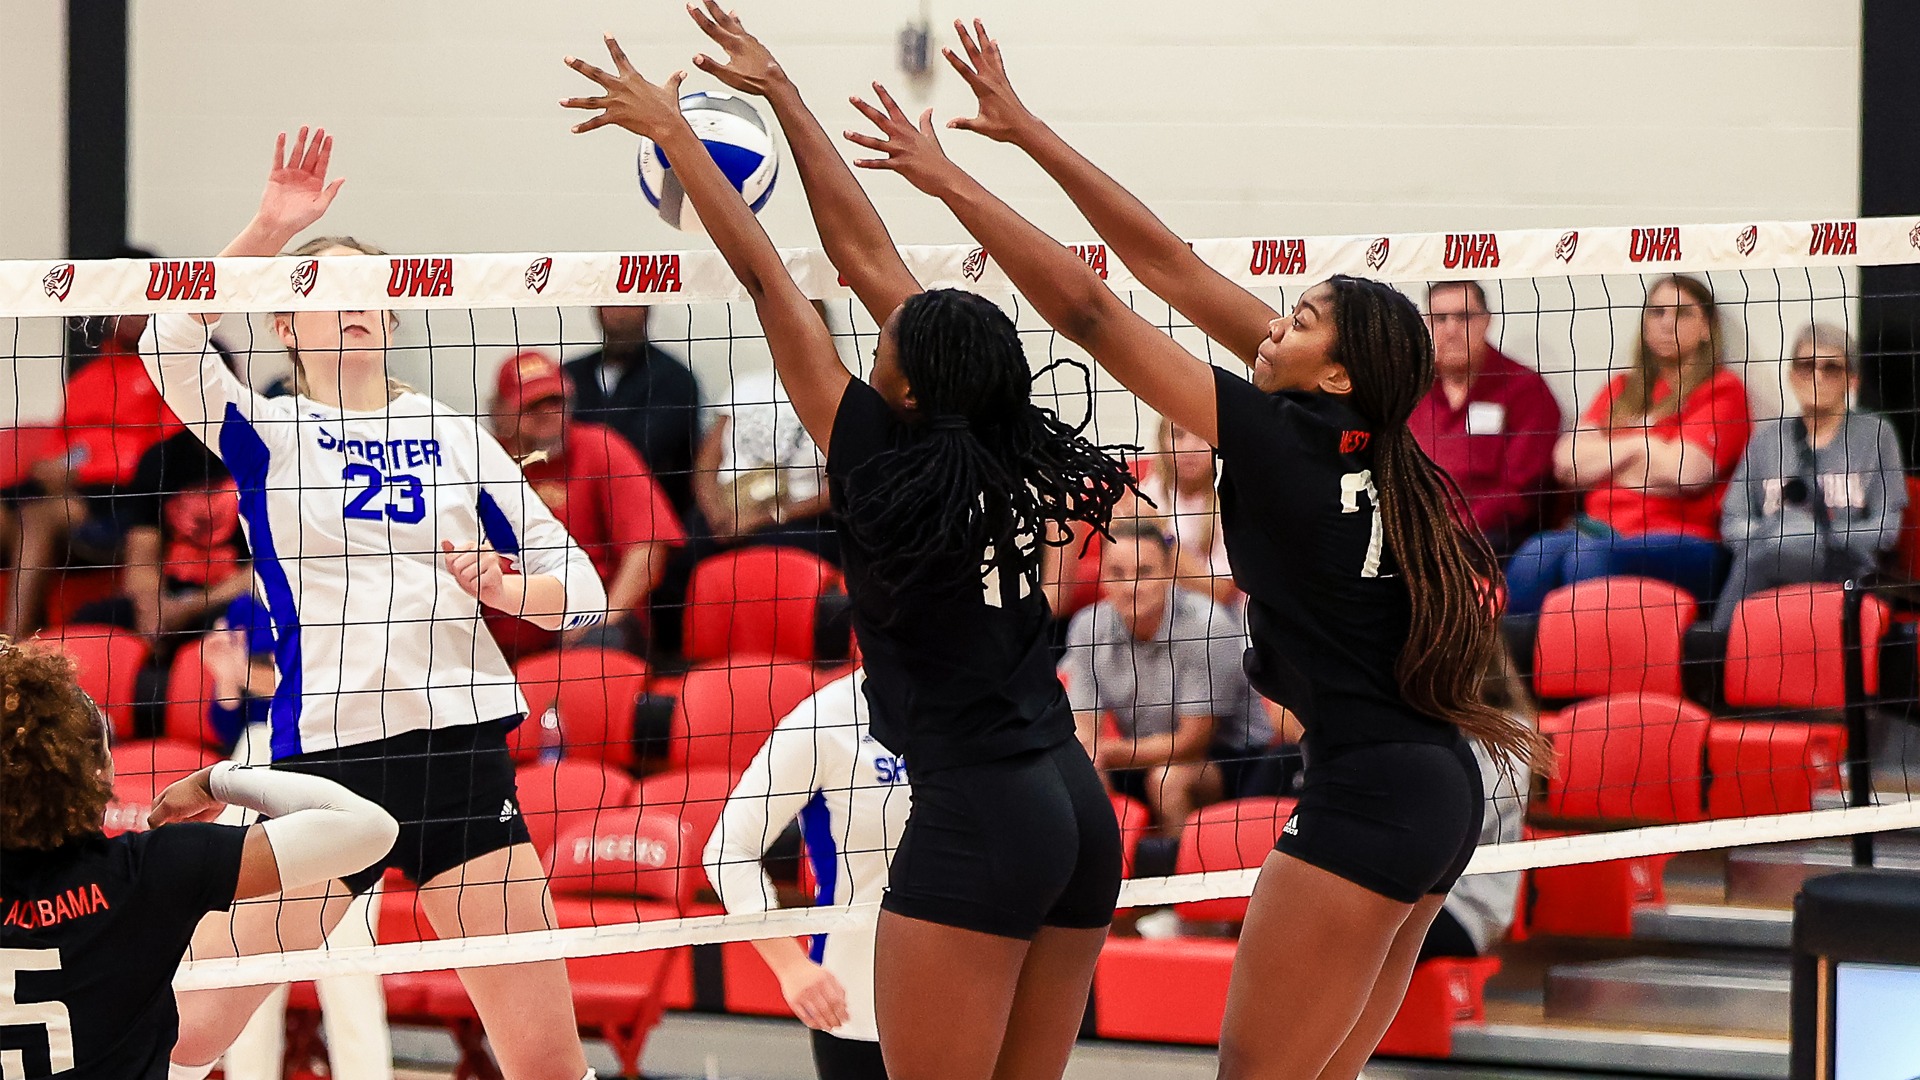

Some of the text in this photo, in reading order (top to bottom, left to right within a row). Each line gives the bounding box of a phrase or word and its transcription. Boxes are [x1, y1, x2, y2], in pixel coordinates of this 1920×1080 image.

[1250, 239, 1307, 275] UWA
[1443, 233, 1500, 269] UWA
[1629, 227, 1682, 263] UWA
[1808, 222, 1857, 256] UWA
[145, 261, 217, 300] UWA
[387, 258, 454, 298] UWA
[616, 254, 682, 293] UWA
[341, 463, 426, 525] 23
